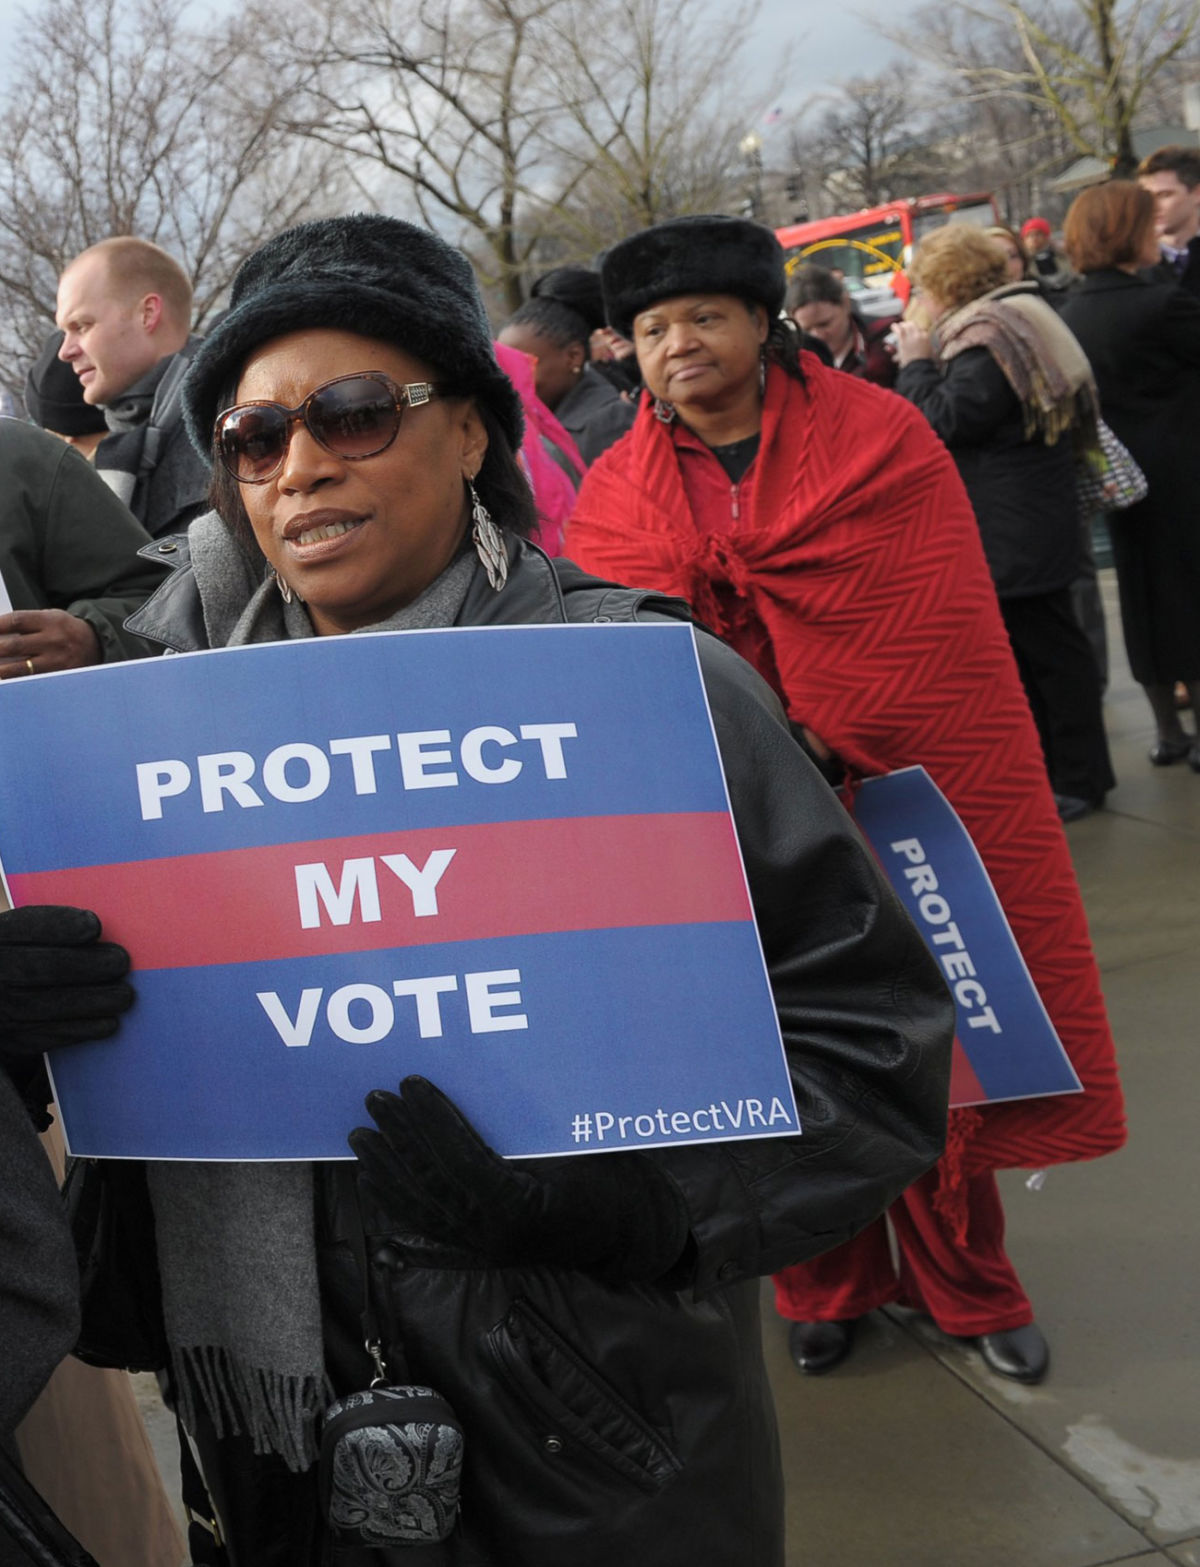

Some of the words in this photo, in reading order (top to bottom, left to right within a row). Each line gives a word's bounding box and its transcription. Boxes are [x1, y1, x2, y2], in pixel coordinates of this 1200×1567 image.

[135, 722, 578, 821] PROTECT
[294, 848, 457, 930] MY
[890, 838, 1003, 1035] PROTECT
[256, 968, 529, 1048] VOTE
[571, 1097, 793, 1144] #ProtectVRA
